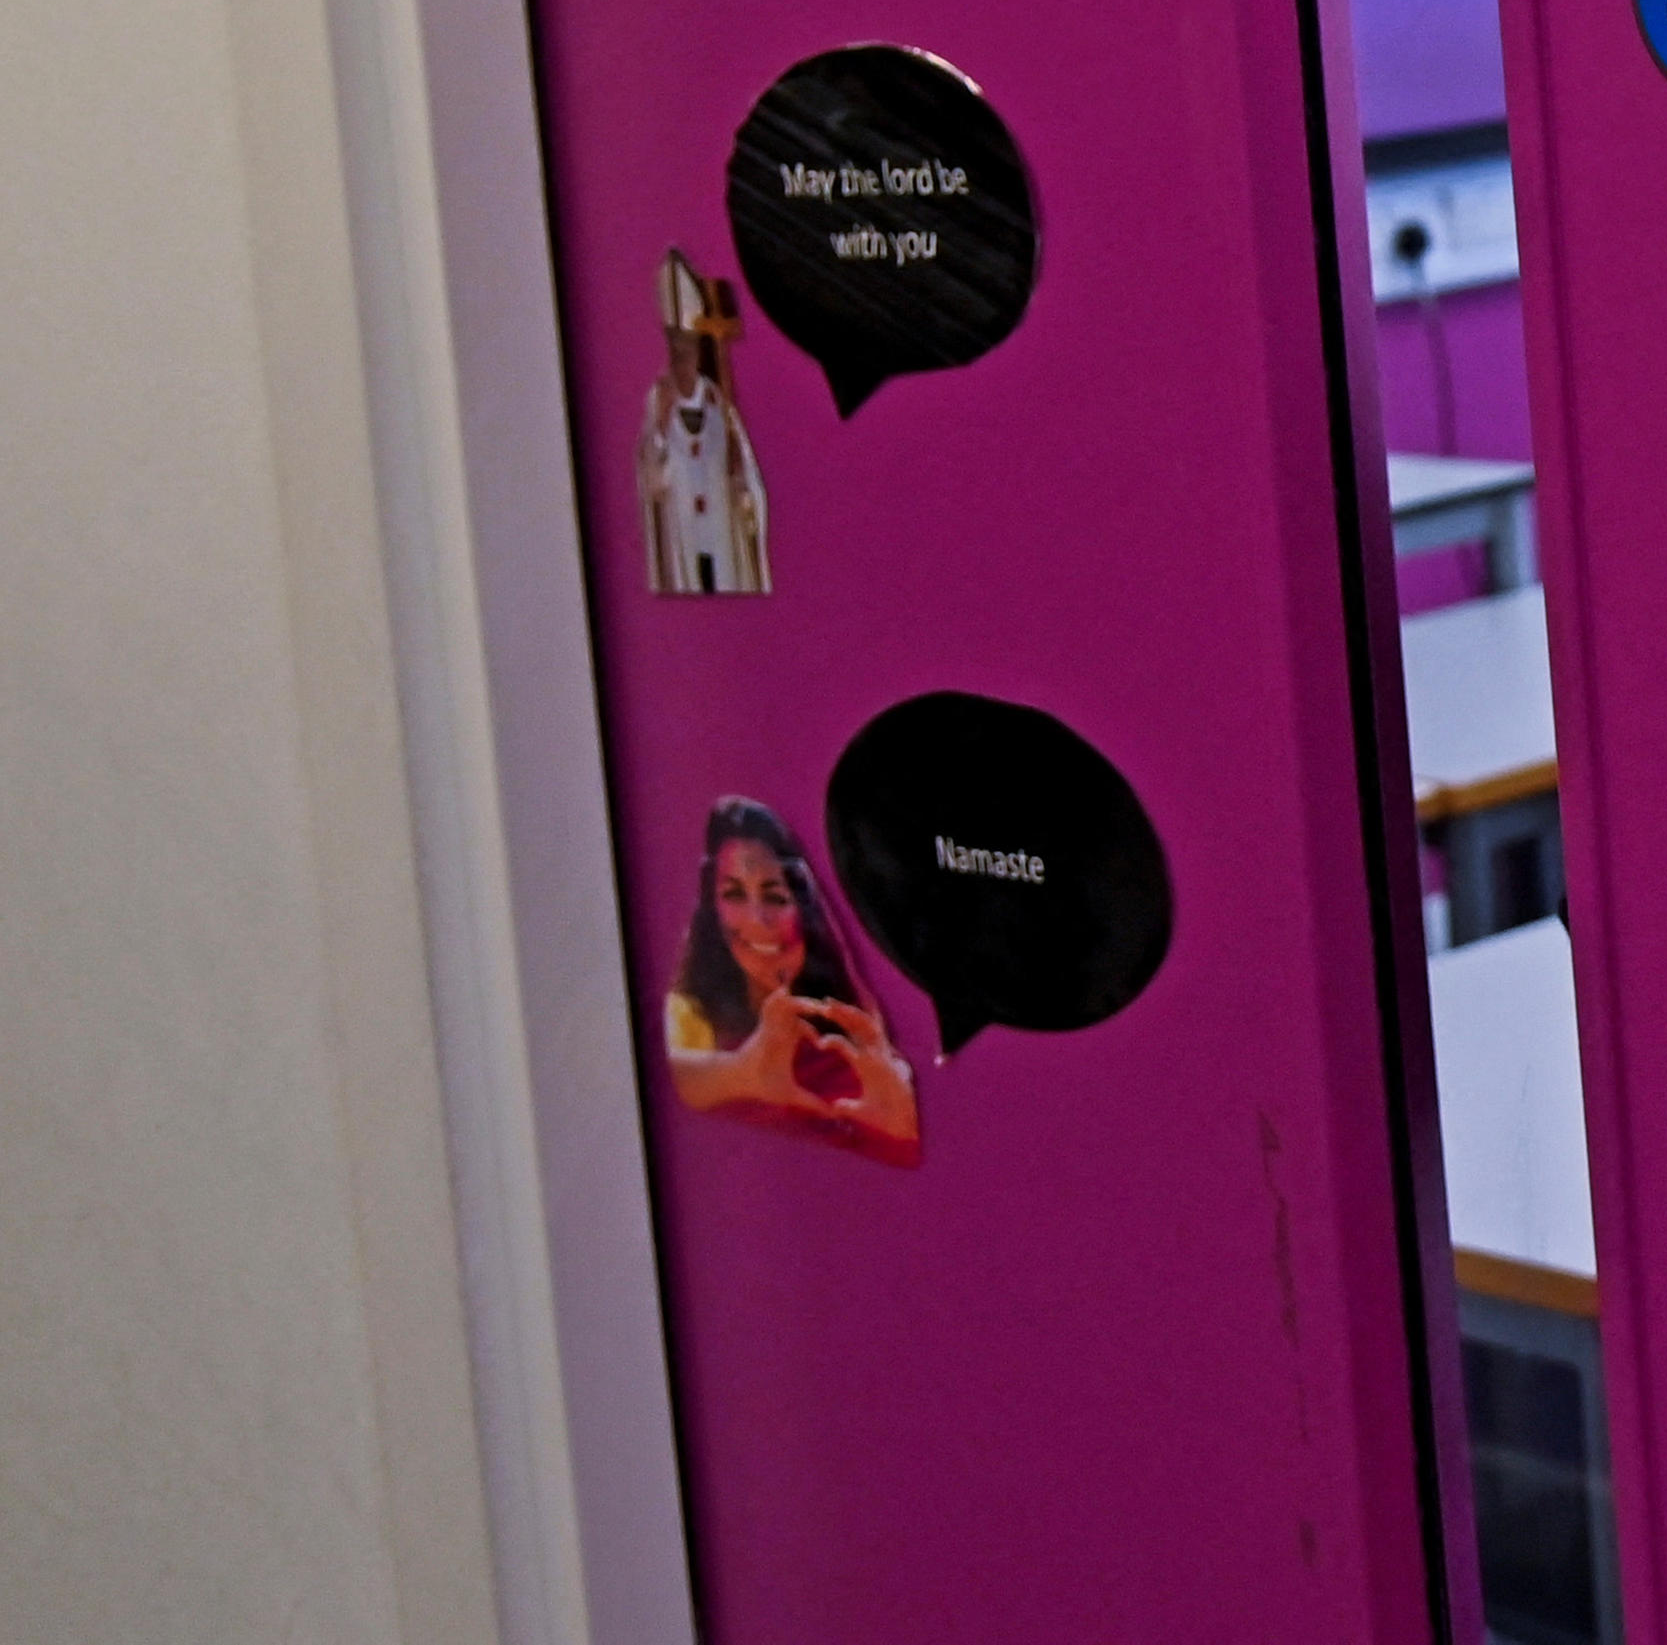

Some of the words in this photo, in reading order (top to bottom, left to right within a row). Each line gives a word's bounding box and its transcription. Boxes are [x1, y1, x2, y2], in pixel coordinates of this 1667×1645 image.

[780, 162, 835, 204] May
[840, 160, 880, 197] the
[882, 158, 934, 197] lord
[935, 158, 969, 196] be
[830, 222, 887, 259] with
[889, 231, 937, 267] you
[935, 835, 1045, 884] Namaste
